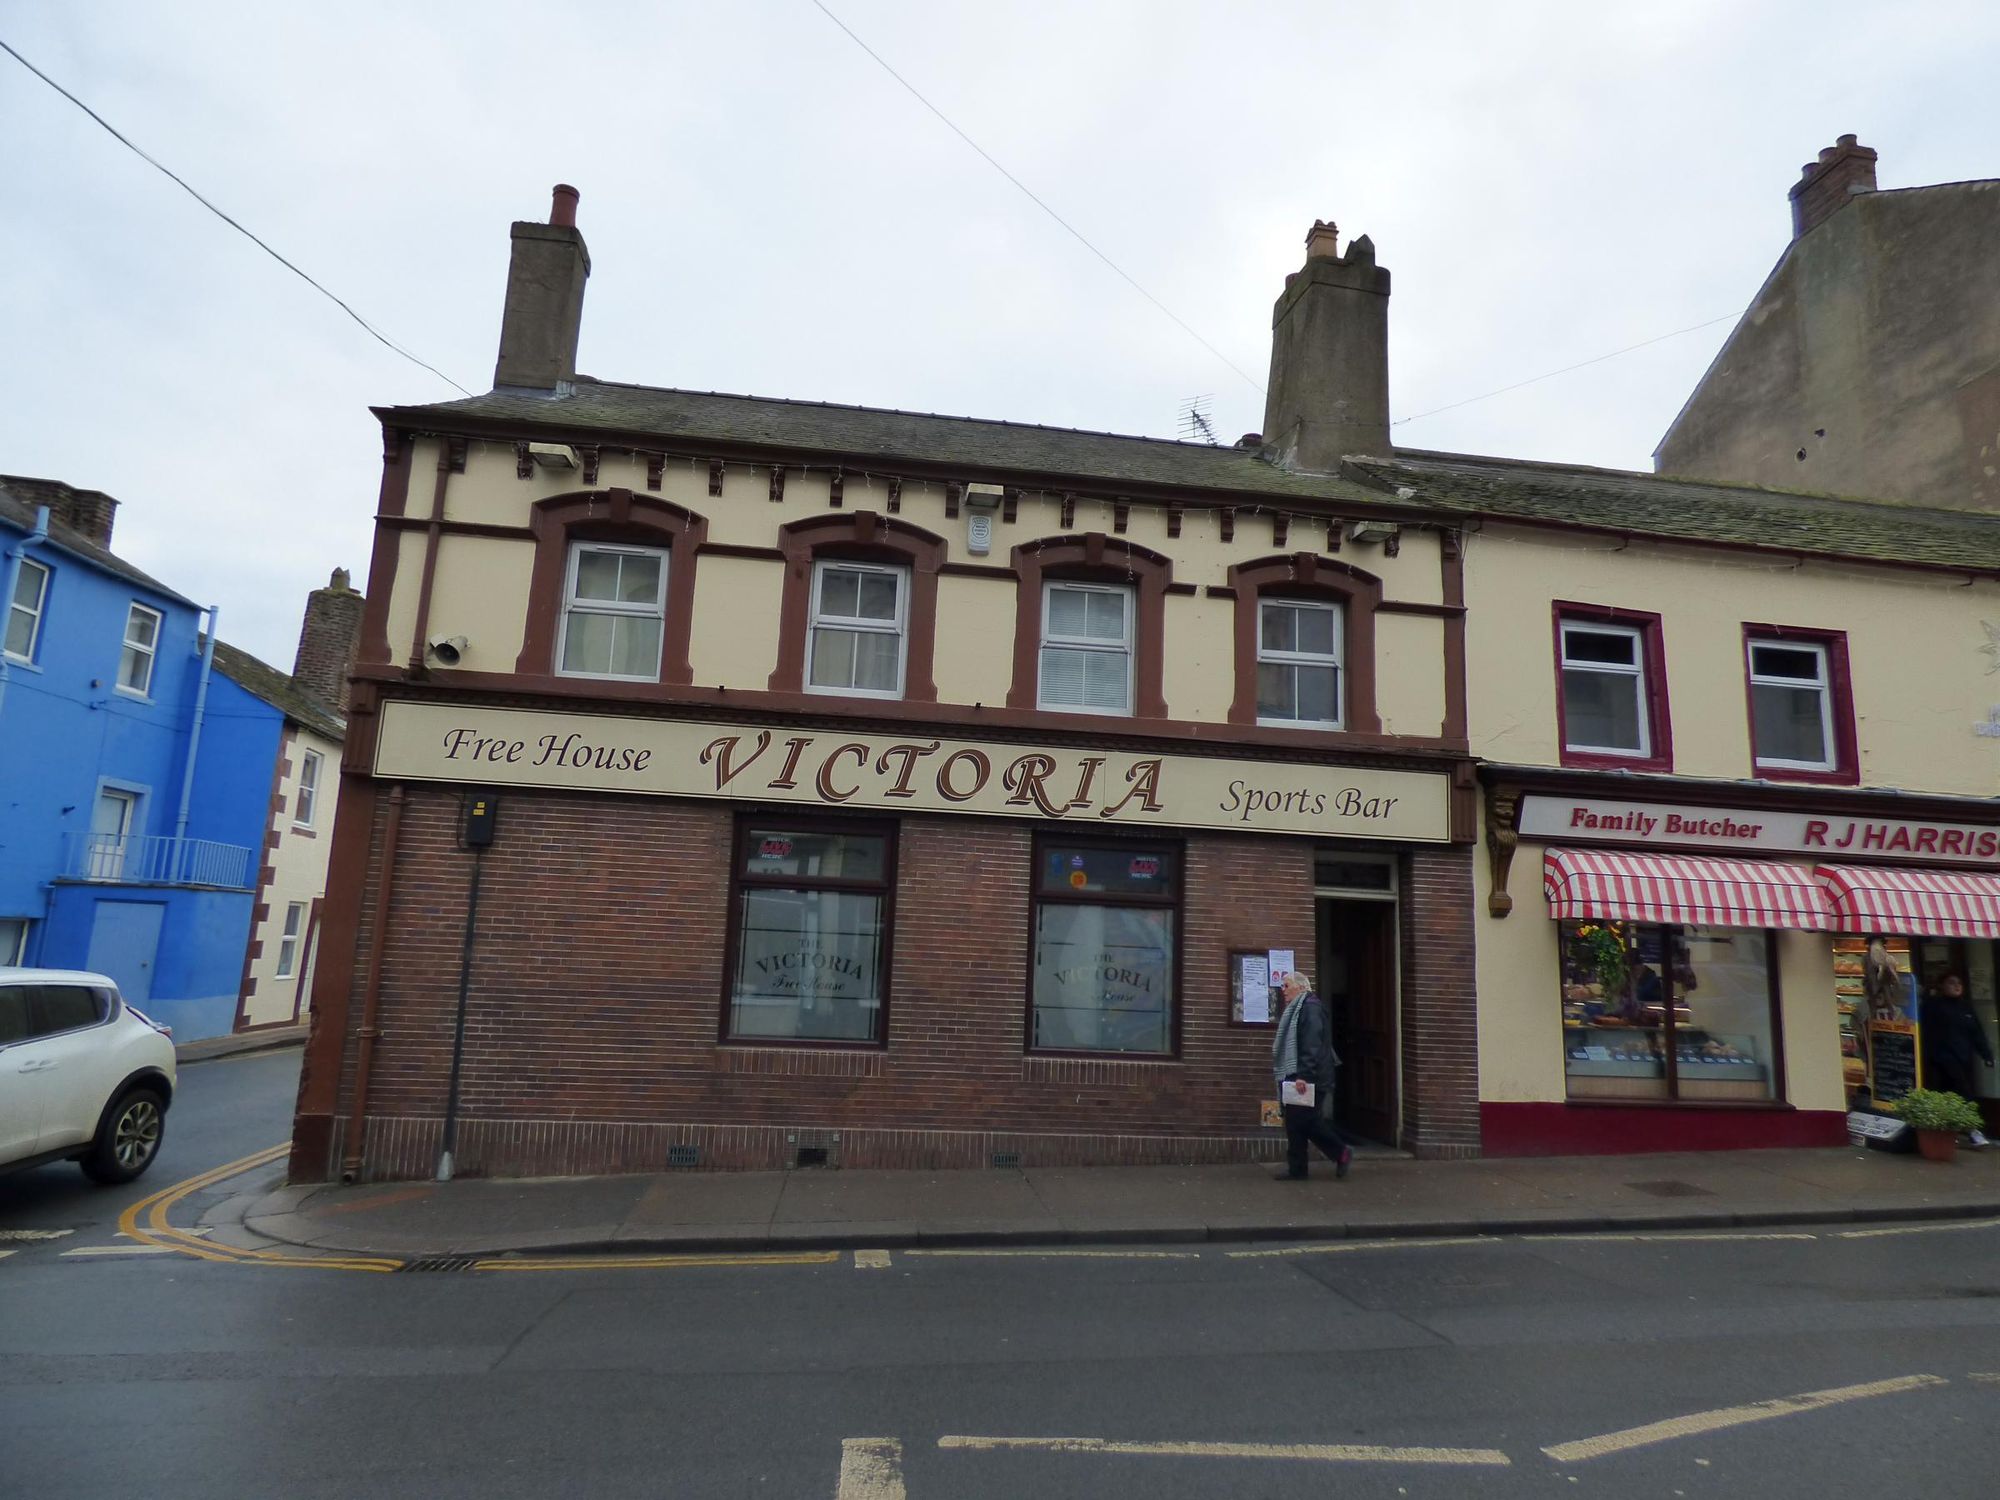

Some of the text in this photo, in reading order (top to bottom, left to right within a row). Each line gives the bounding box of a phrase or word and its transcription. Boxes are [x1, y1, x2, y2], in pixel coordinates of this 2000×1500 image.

[443, 728, 652, 772] Free House
[699, 729, 1165, 819] VICTORIA
[1219, 779, 1399, 822] Sports Bar
[1569, 807, 1763, 839] Family Butcher
[1803, 820, 2000, 857] R J HARRIS
[755, 952, 863, 980] VICTORIA
